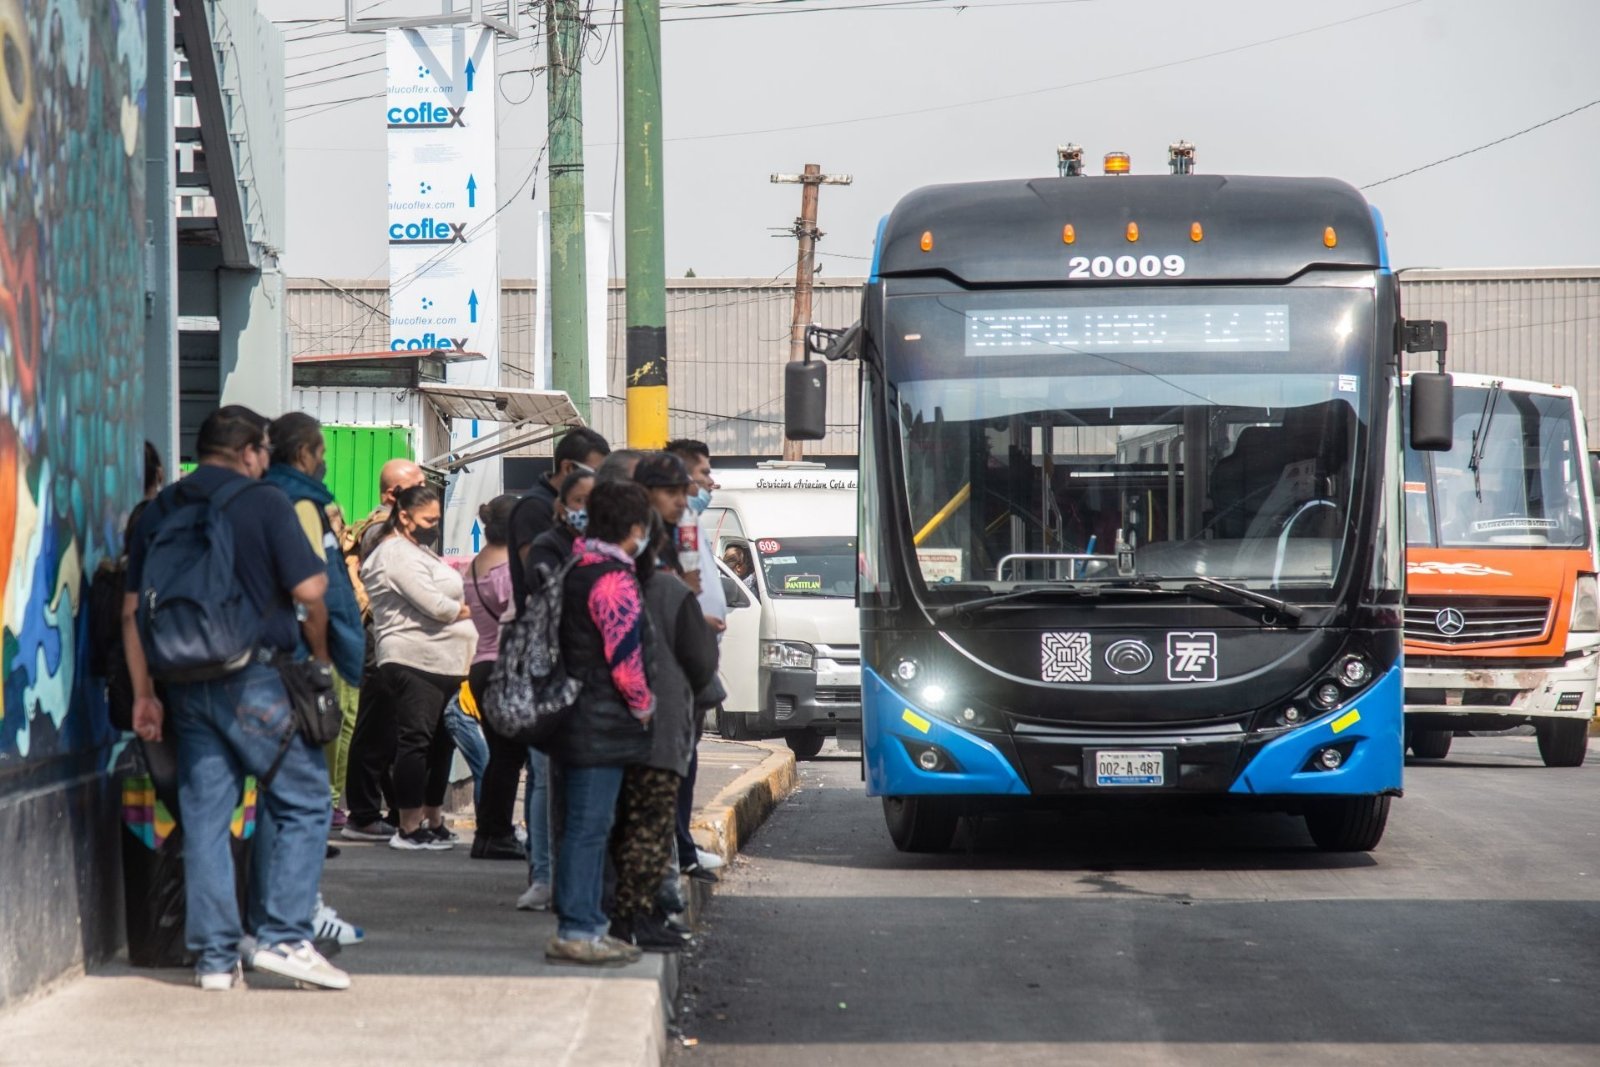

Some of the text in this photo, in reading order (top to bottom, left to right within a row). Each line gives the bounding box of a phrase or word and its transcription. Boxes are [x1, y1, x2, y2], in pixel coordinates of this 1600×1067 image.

[387, 102, 466, 128] coflex
[387, 201, 455, 210] alucoflex.com
[389, 217, 468, 244] coflex
[1069, 254, 1185, 278] 20009
[390, 333, 469, 353] coflex
[758, 540, 778, 551] 609
[785, 581, 821, 589] PANTITLAN
[1099, 761, 1161, 776] 002-A-487
